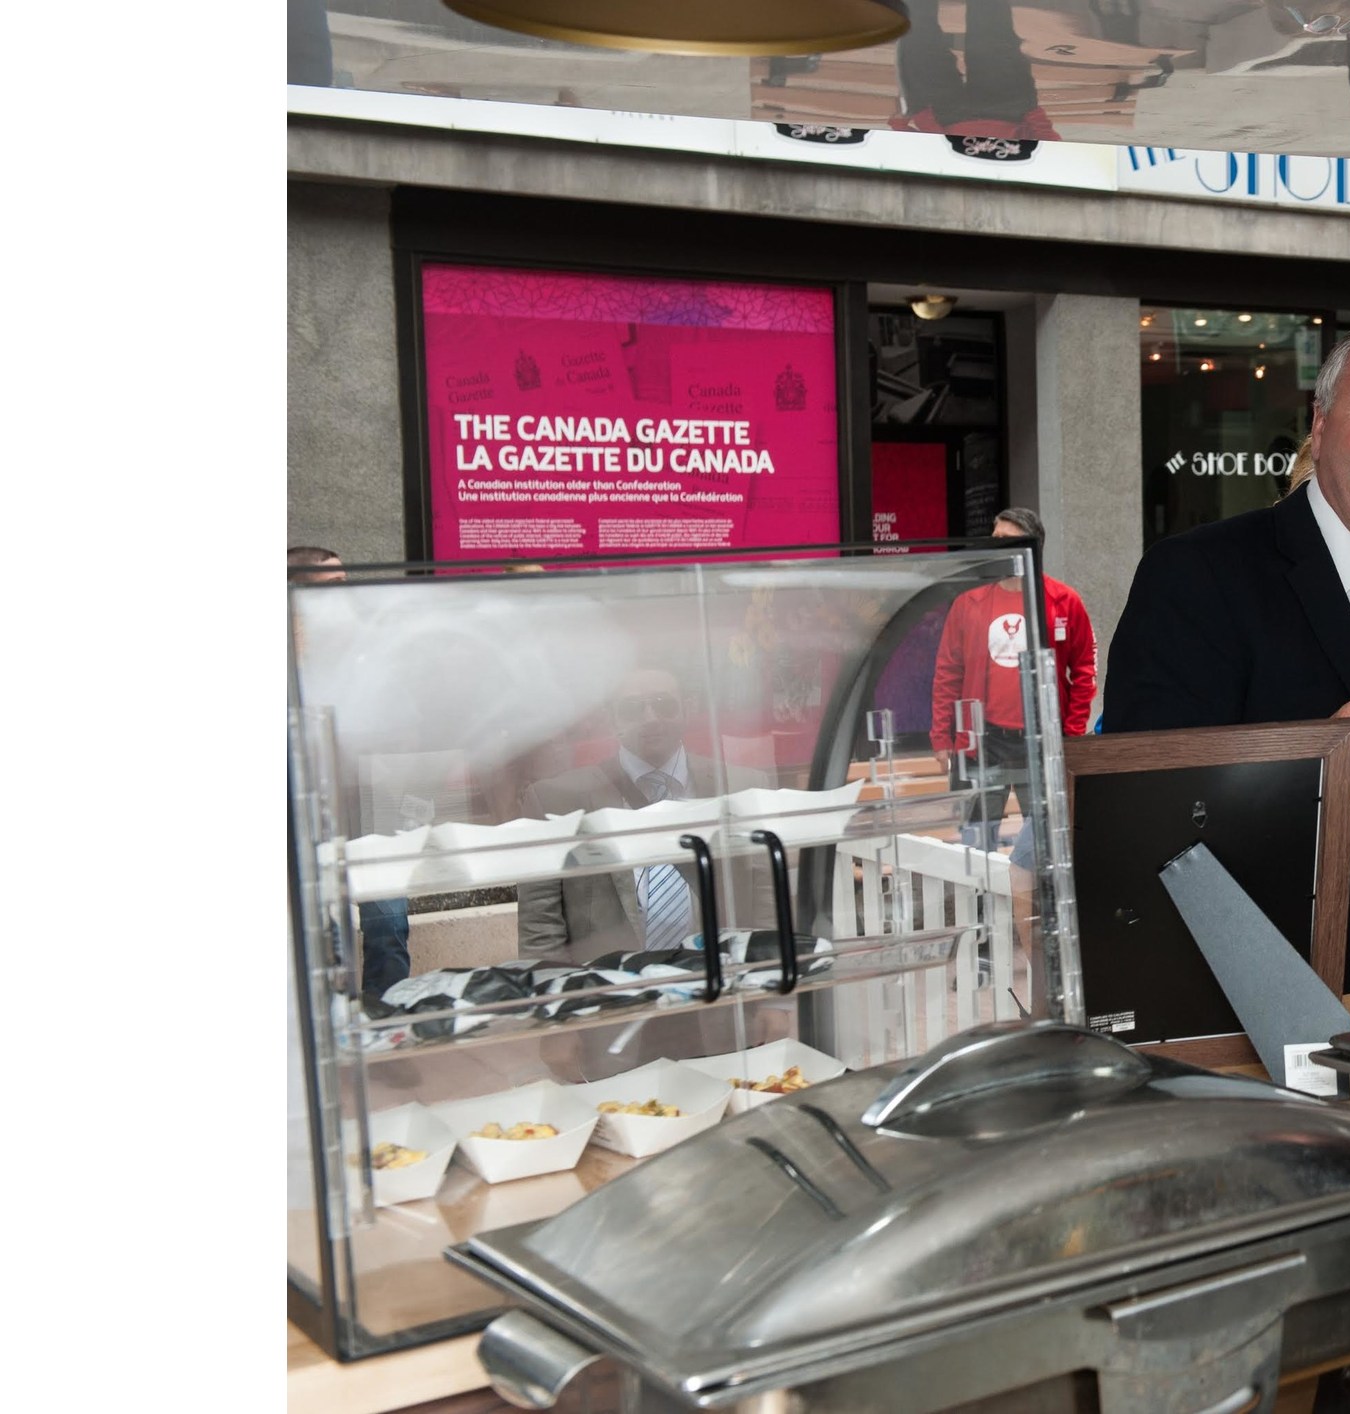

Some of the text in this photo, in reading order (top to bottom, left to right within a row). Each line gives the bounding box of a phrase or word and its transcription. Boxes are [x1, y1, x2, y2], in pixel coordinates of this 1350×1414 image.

[454, 414, 750, 445] THE CANADA GAZETTE
[456, 445, 775, 474] LA GAZETTE DU CANADA
[1191, 452, 1248, 476] SHOE
[1254, 452, 1298, 476] BOX
[458, 479, 682, 491] A Canadian institution older than Confederation
[458, 491, 743, 504] Une institution canadienne plus ancienne que la Confédération
[873, 512, 897, 523] DING
